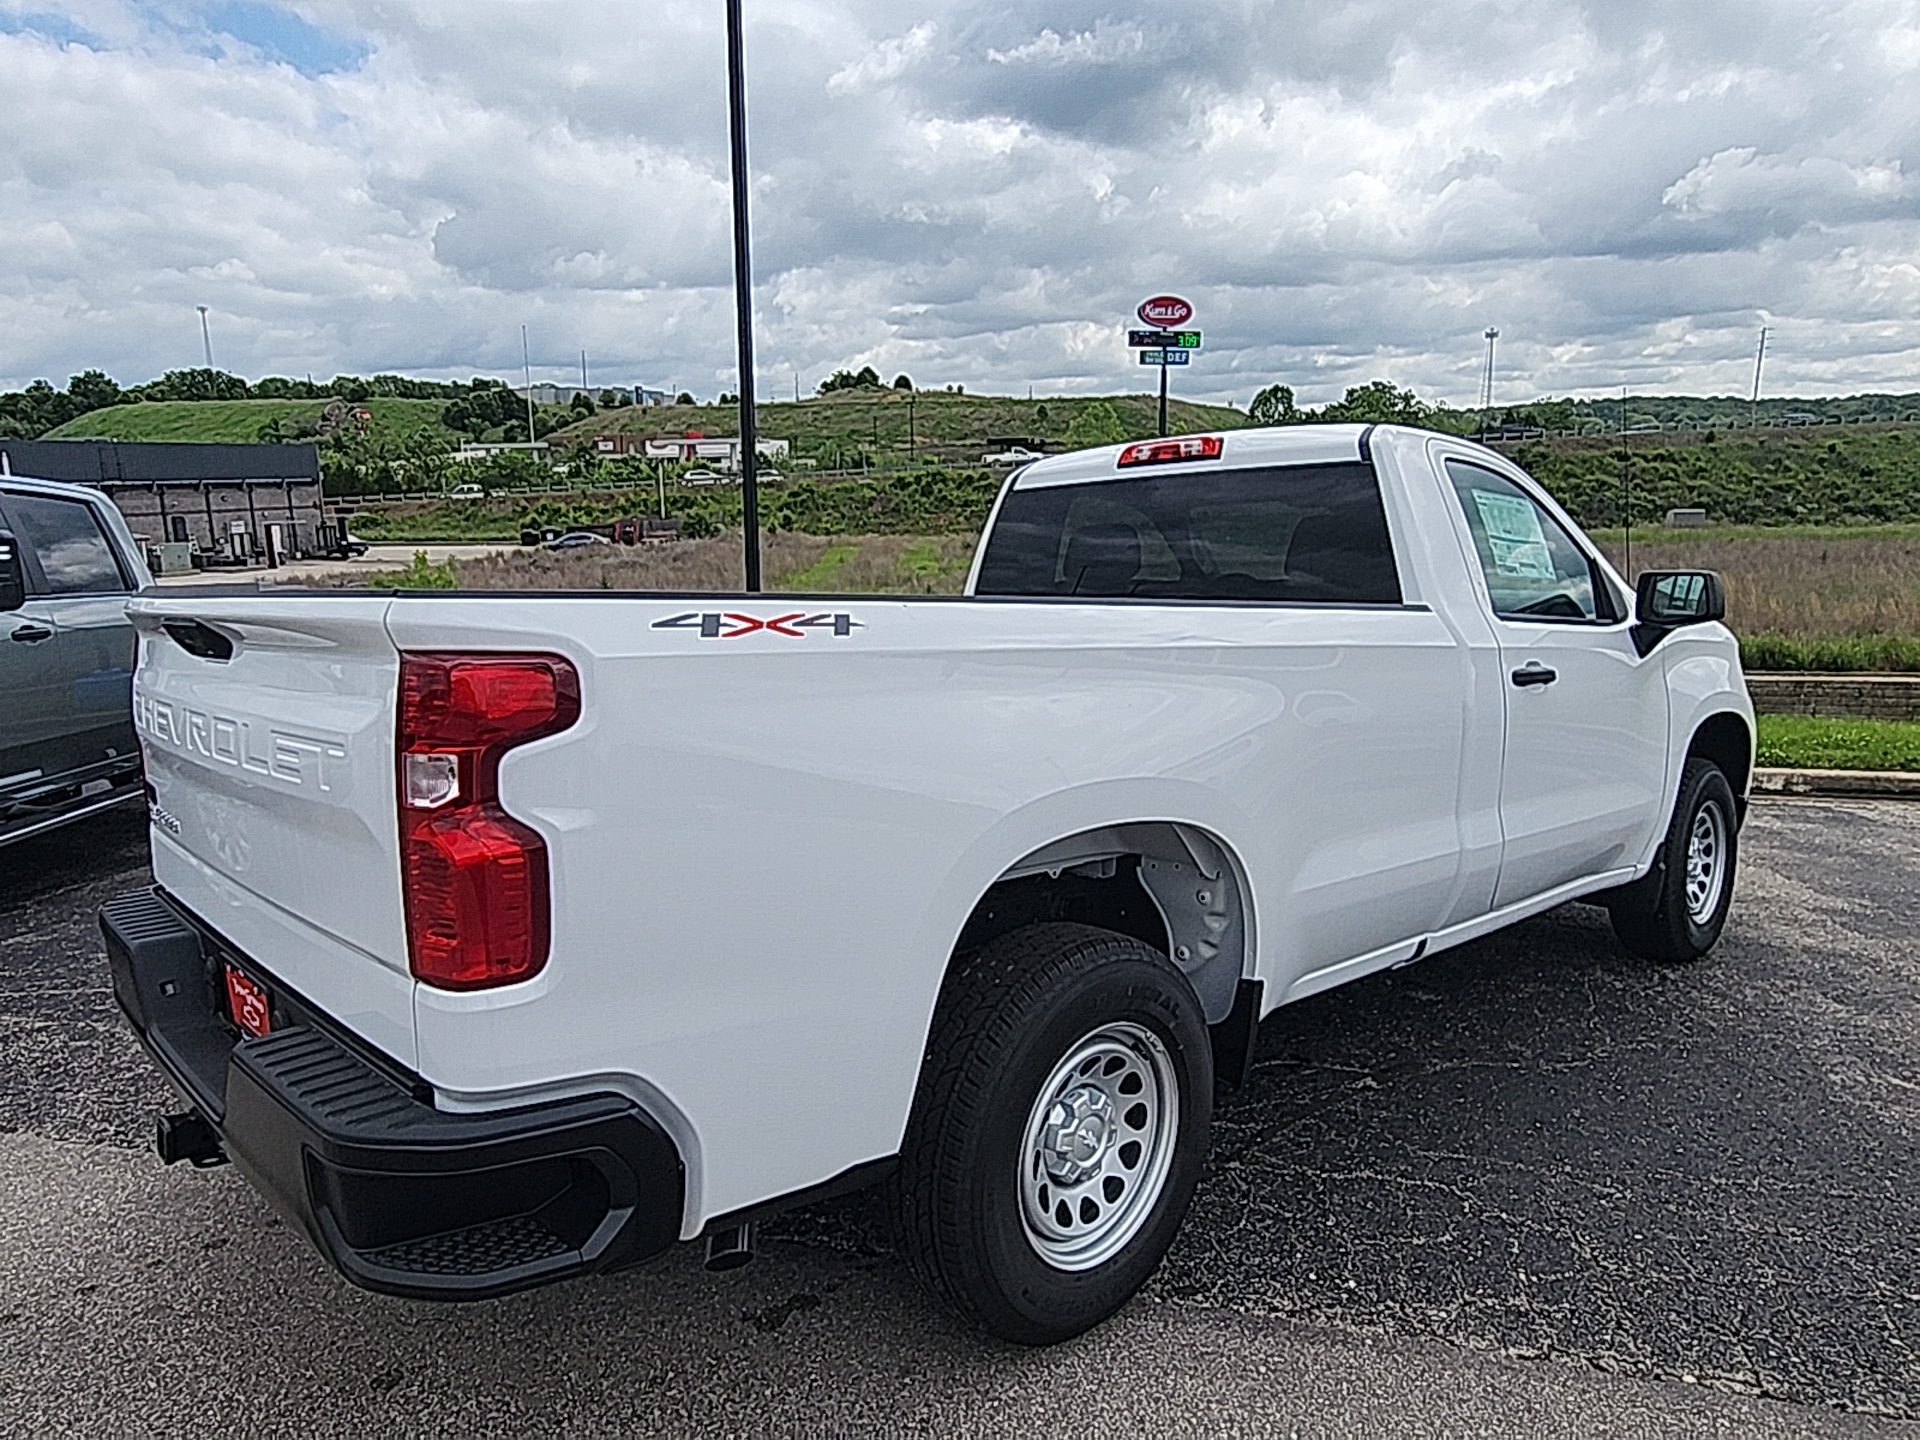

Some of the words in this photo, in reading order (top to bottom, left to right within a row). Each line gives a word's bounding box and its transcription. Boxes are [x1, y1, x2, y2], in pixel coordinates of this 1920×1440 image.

[1145, 303, 1166, 316] Kum
[1173, 304, 1188, 317] Go
[1167, 352, 1188, 362] DEF
